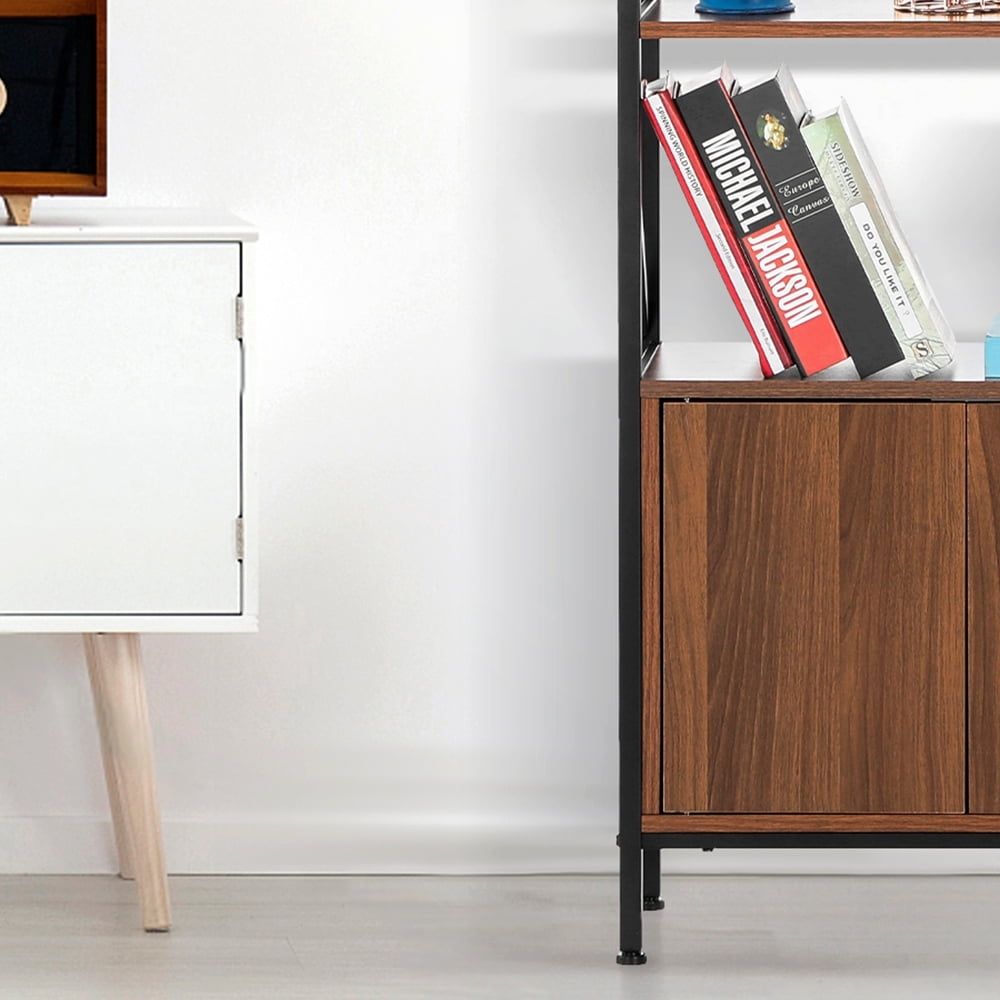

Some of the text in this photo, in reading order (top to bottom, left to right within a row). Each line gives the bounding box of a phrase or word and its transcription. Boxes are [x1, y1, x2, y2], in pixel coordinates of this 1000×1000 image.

[656, 106, 704, 197] SPINNING WORLD HISTORY
[702, 128, 774, 233] MICHAEL
[778, 175, 821, 198] Europe
[830, 142, 862, 198] SIDESHOW
[787, 196, 831, 218] Canvas
[748, 224, 822, 328] JACKSON
[862, 223, 874, 240] DO
[872, 242, 887, 266] YOU
[882, 267, 899, 293] LIKE
[894, 294, 906, 308] IT
